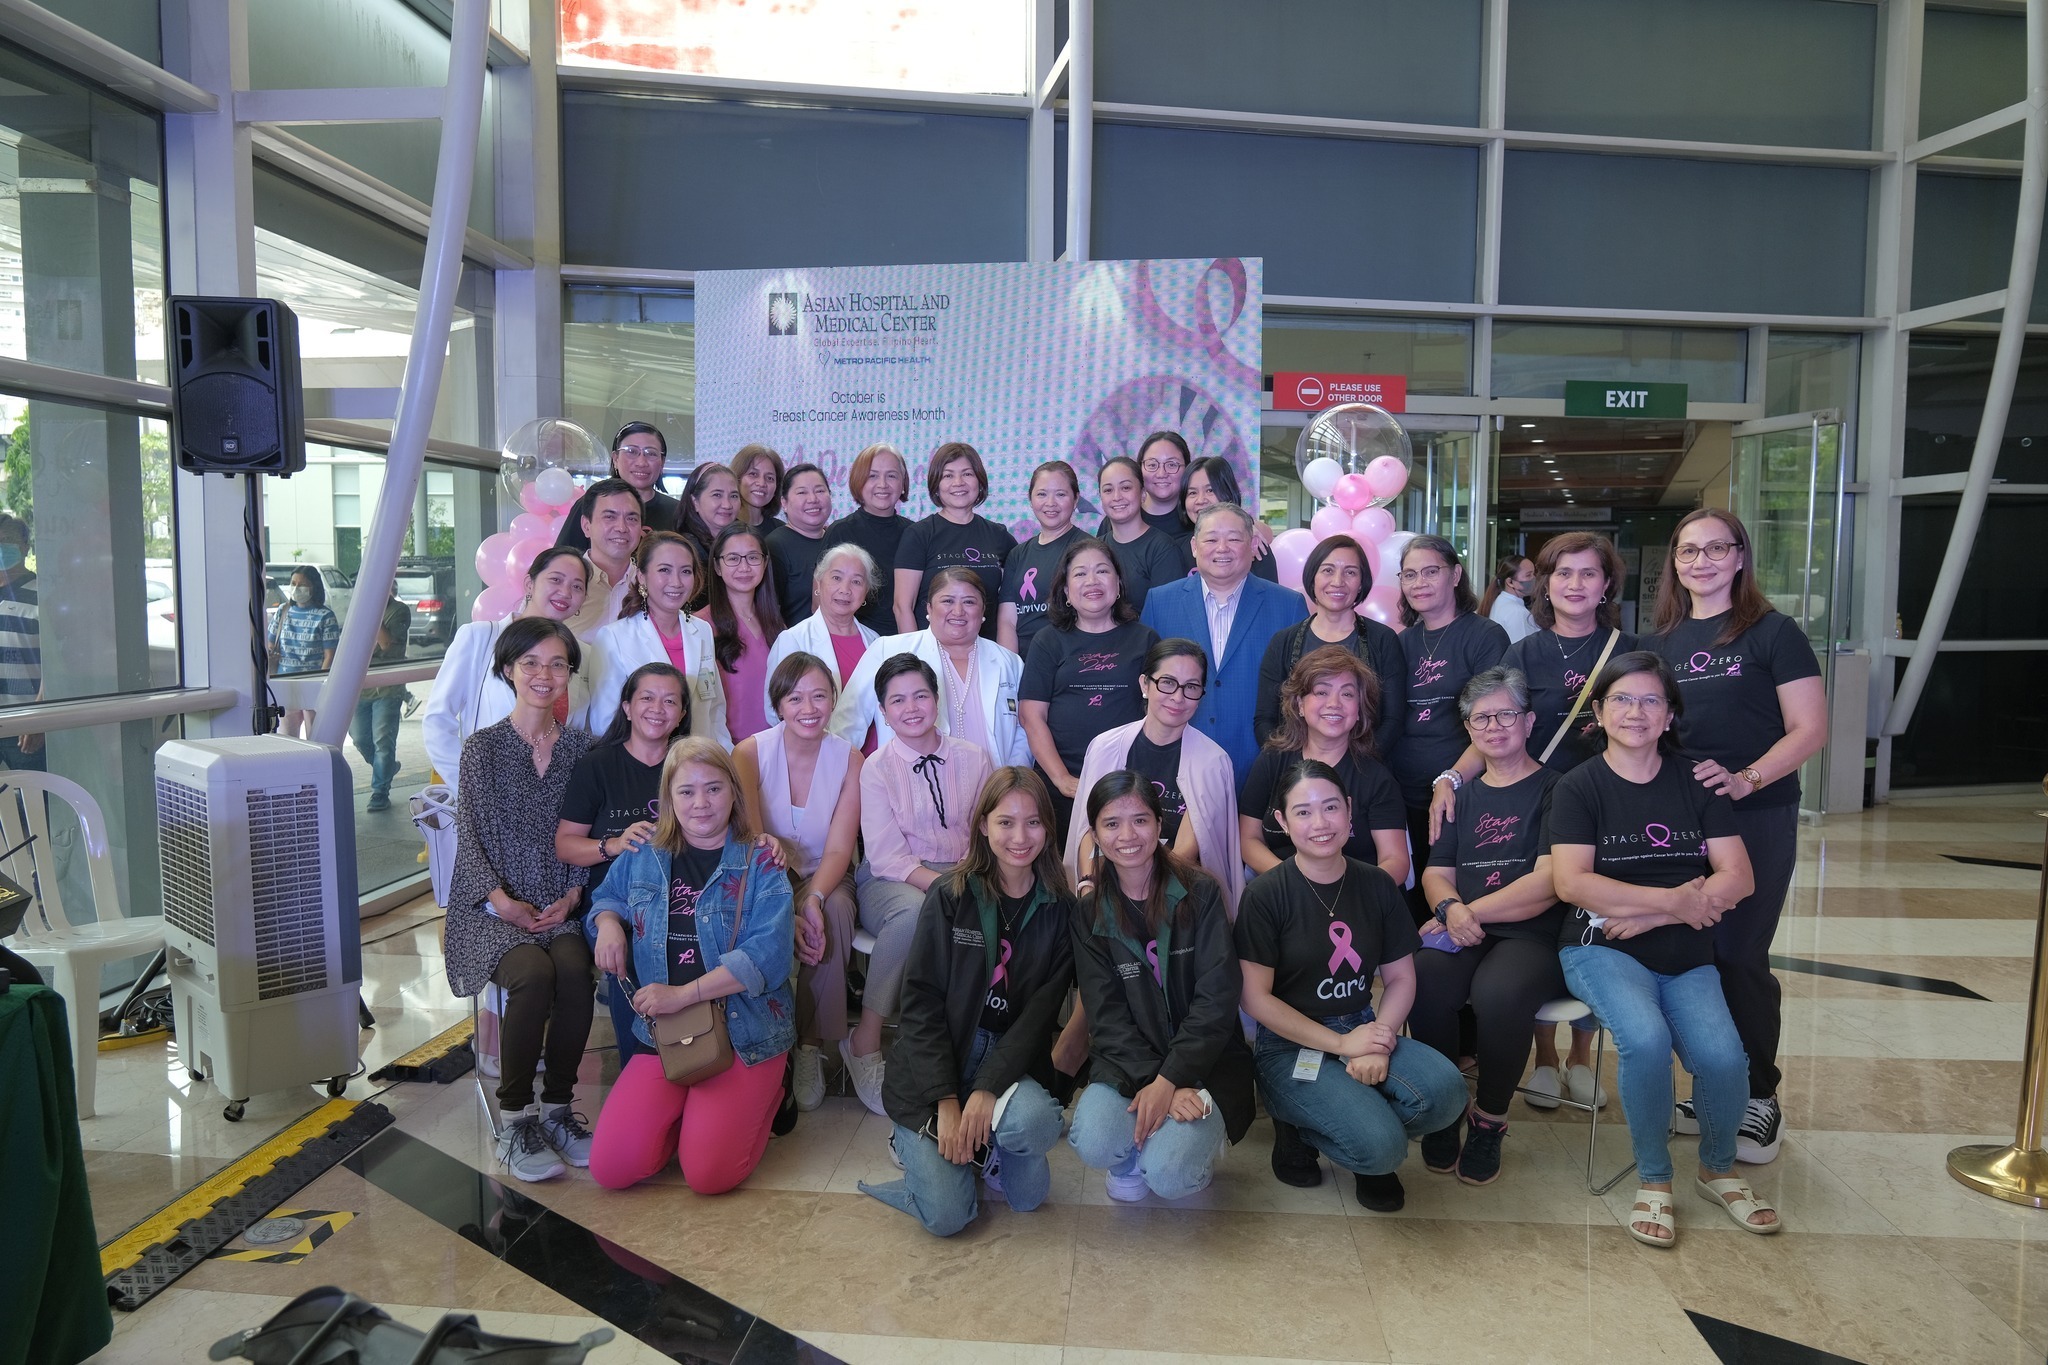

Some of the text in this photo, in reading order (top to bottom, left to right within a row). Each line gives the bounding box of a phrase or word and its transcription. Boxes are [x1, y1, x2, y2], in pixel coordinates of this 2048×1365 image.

[803, 293, 949, 312] ASIAN HOSPITAL AND
[815, 313, 936, 332] MEDICAL CENTER
[814, 338, 838, 347] Global
[1330, 383, 1380, 392] PLEASE USE
[832, 390, 885, 404] October is
[1328, 394, 1382, 402] OTHER DOOR
[1606, 390, 1648, 408] EXIT
[773, 408, 946, 422] Breast Cancer Awareness Month
[1079, 659, 1117, 673] Zero
[1710, 655, 1742, 665] ZERO
[1413, 670, 1444, 687] Zero
[1564, 670, 1588, 691] Sta
[1164, 791, 1183, 800] ZER
[610, 808, 647, 818] STAGE
[1475, 813, 1520, 833] Stage
[1475, 828, 1516, 848] Zero
[1603, 833, 1647, 845] STAGE
[671, 878, 703, 903] Stag
[670, 898, 696, 916] Zer
[1316, 974, 1366, 1000] Care
